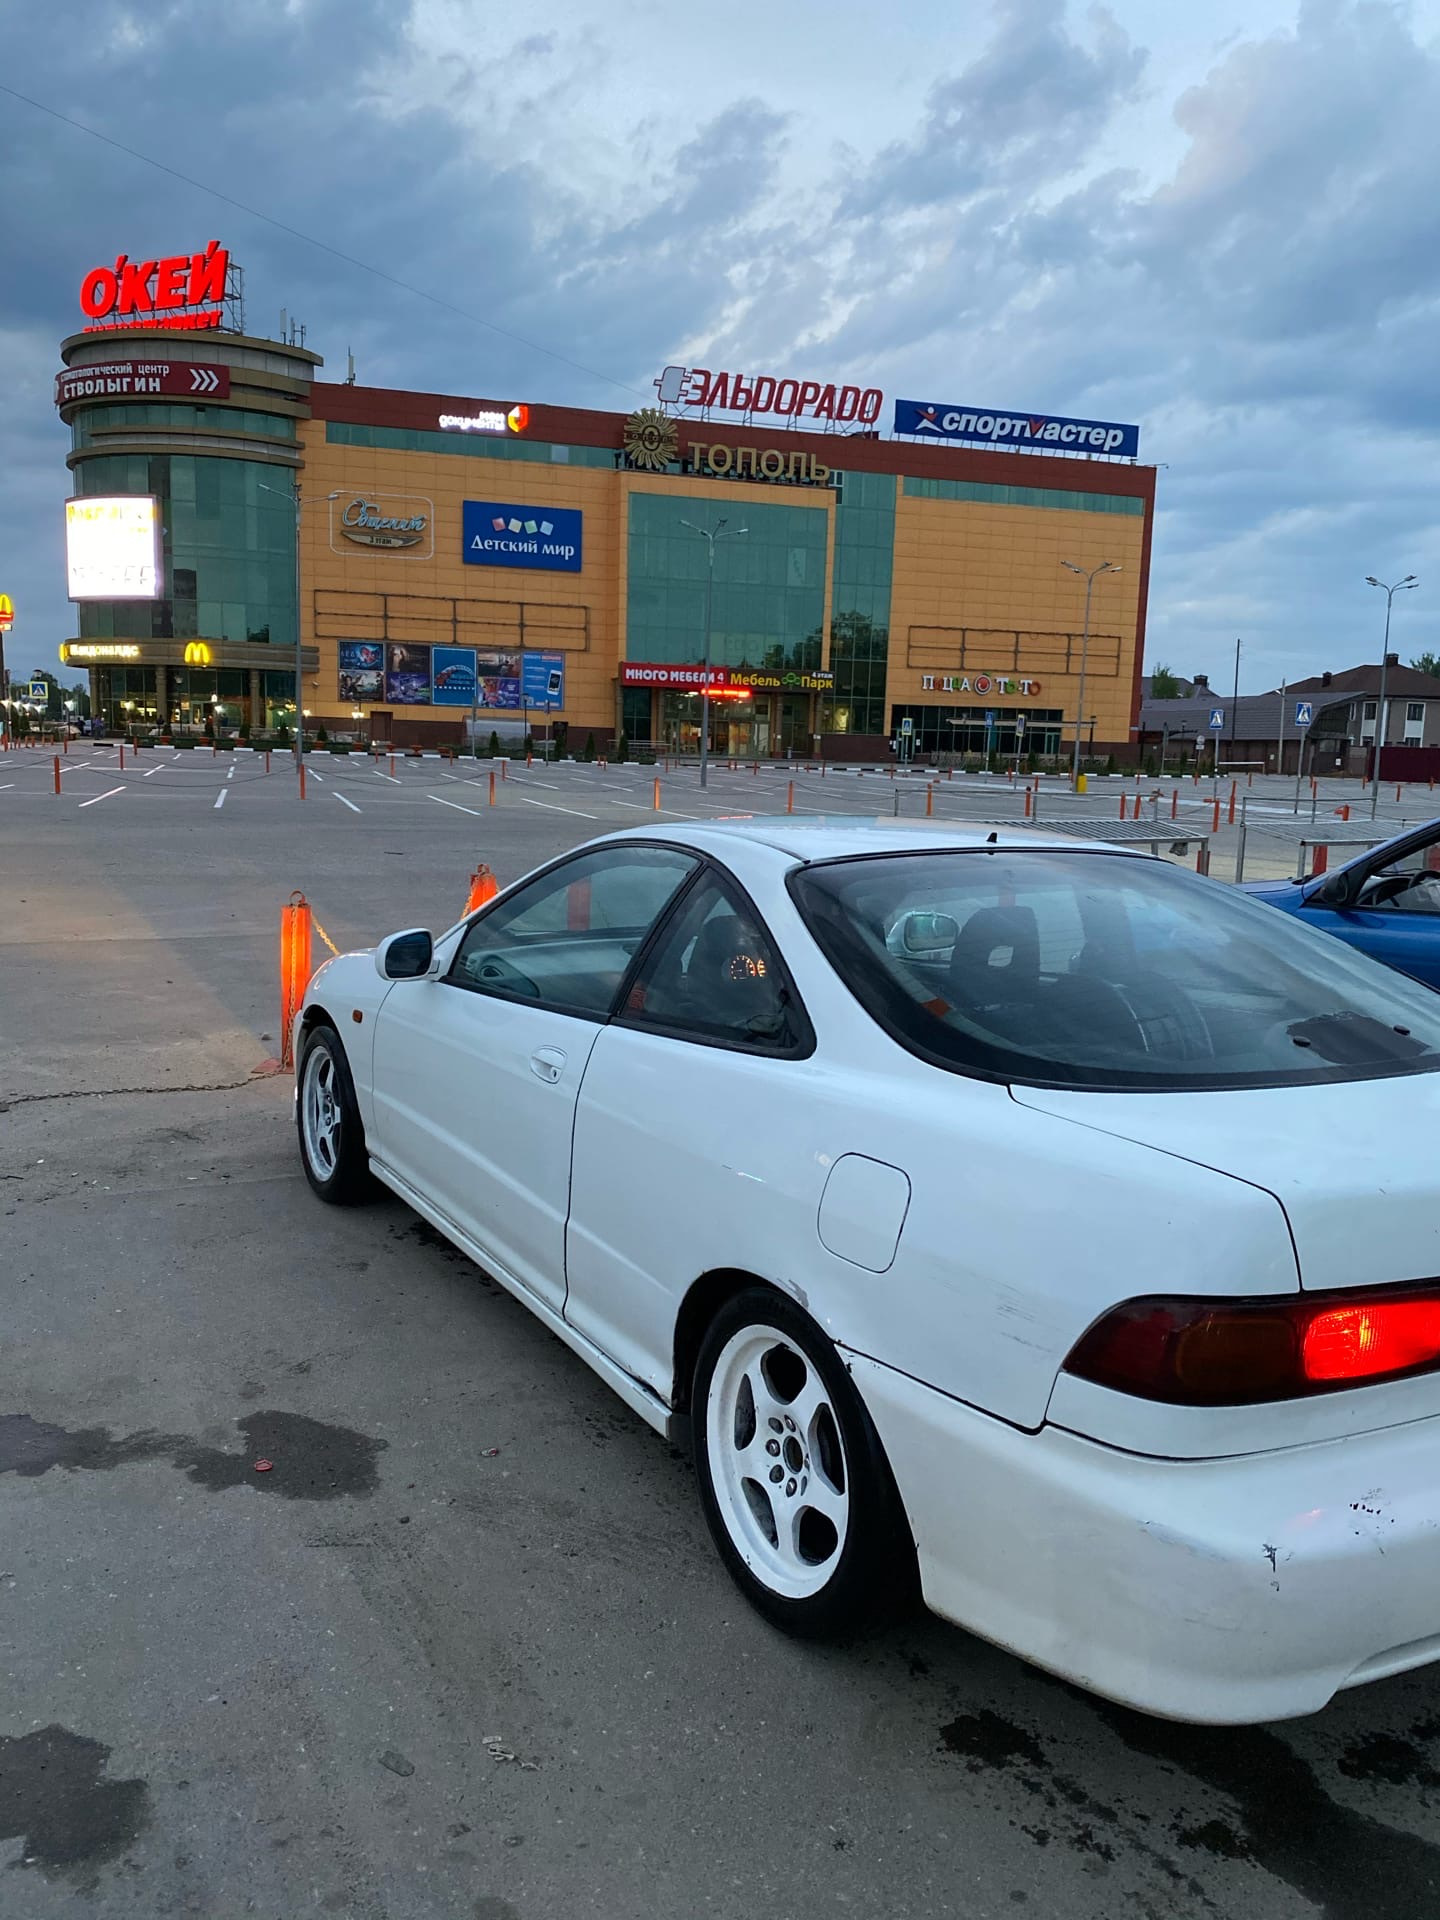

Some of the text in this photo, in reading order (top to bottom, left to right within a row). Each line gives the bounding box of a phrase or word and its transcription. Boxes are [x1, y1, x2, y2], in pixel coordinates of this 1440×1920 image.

[138, 365, 170, 378] центр
[63, 377, 161, 399] СТВОЛЫГИН
[688, 441, 830, 481] ТОПОЛЬ
[471, 535, 575, 560] Детский мир
[625, 668, 669, 681] МНОГО
[670, 671, 715, 683] МЕБЕЛИ
[730, 673, 833, 690] Мебель Парк
